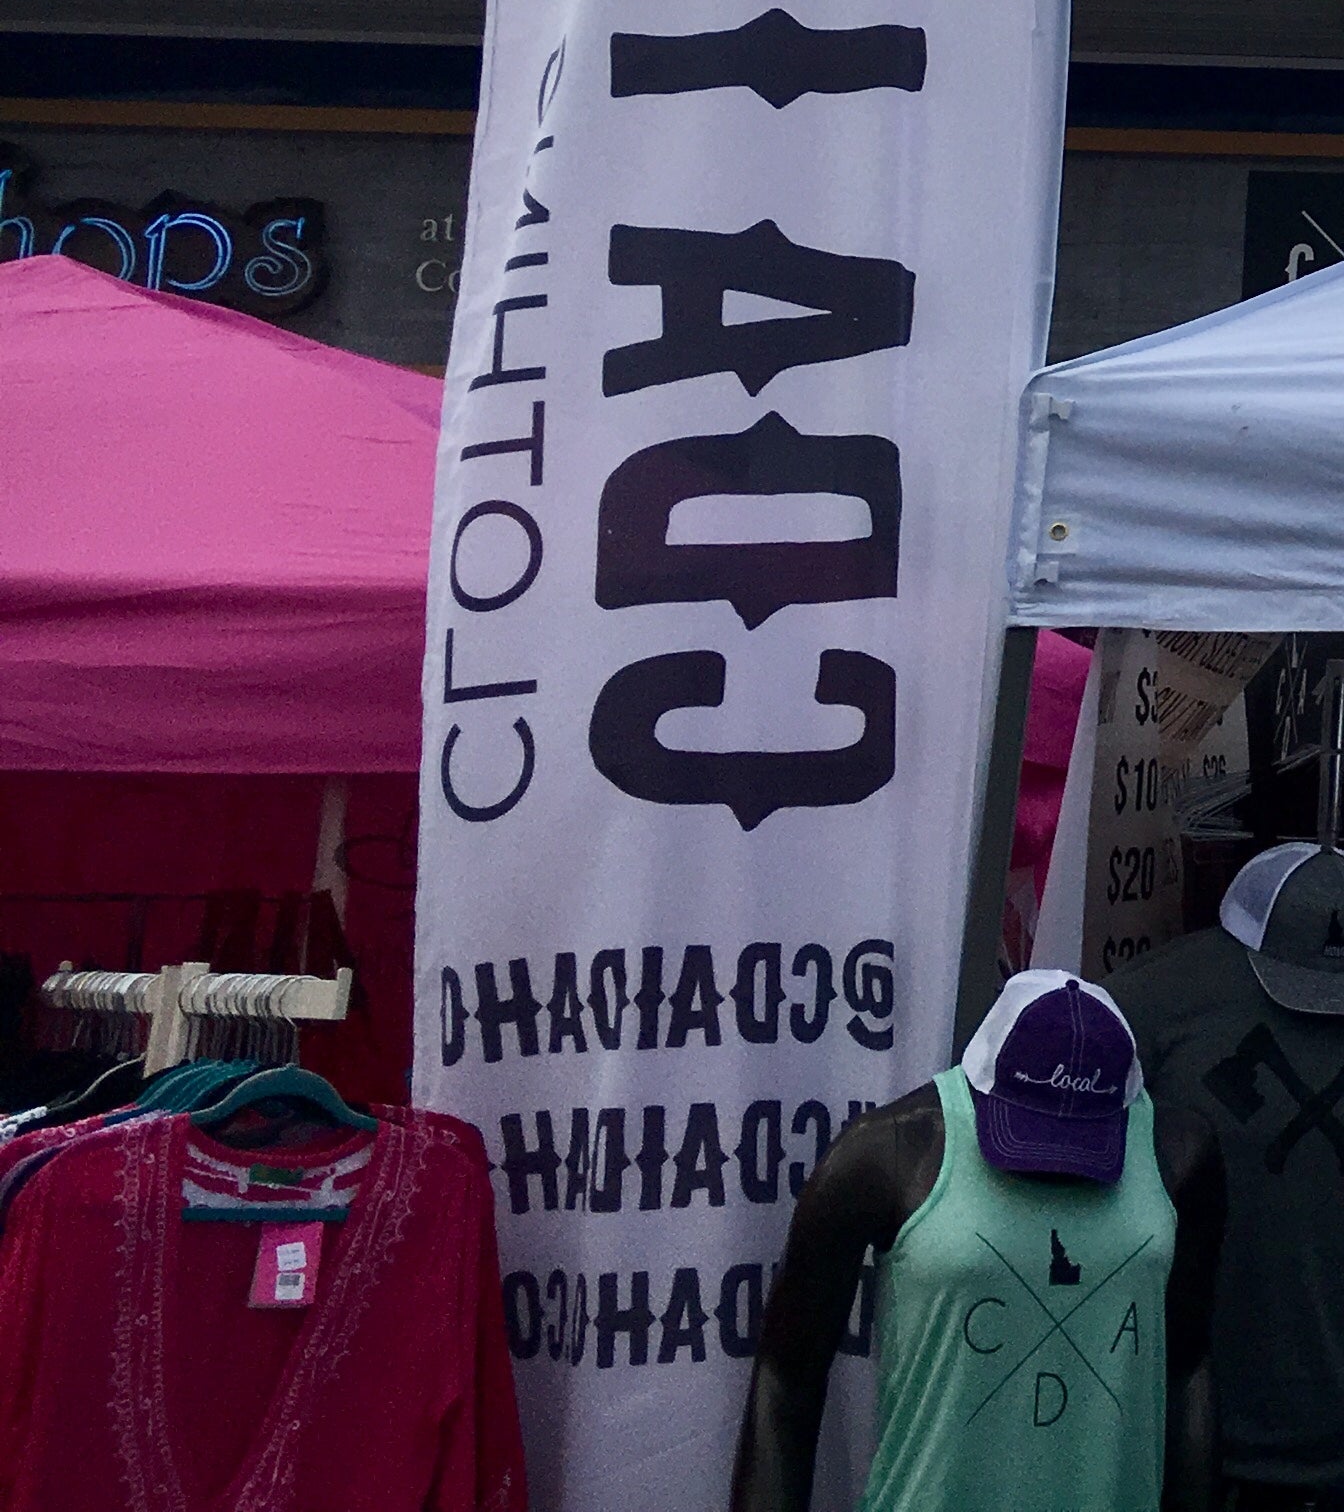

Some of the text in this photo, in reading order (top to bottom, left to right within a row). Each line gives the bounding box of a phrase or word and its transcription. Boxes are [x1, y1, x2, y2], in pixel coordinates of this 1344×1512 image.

[420, 213, 456, 242] at
[1115, 755, 1158, 814] $10
[1107, 845, 1154, 905] $20
[1048, 1063, 1106, 1093] local
[963, 1298, 1140, 1427] C D A
